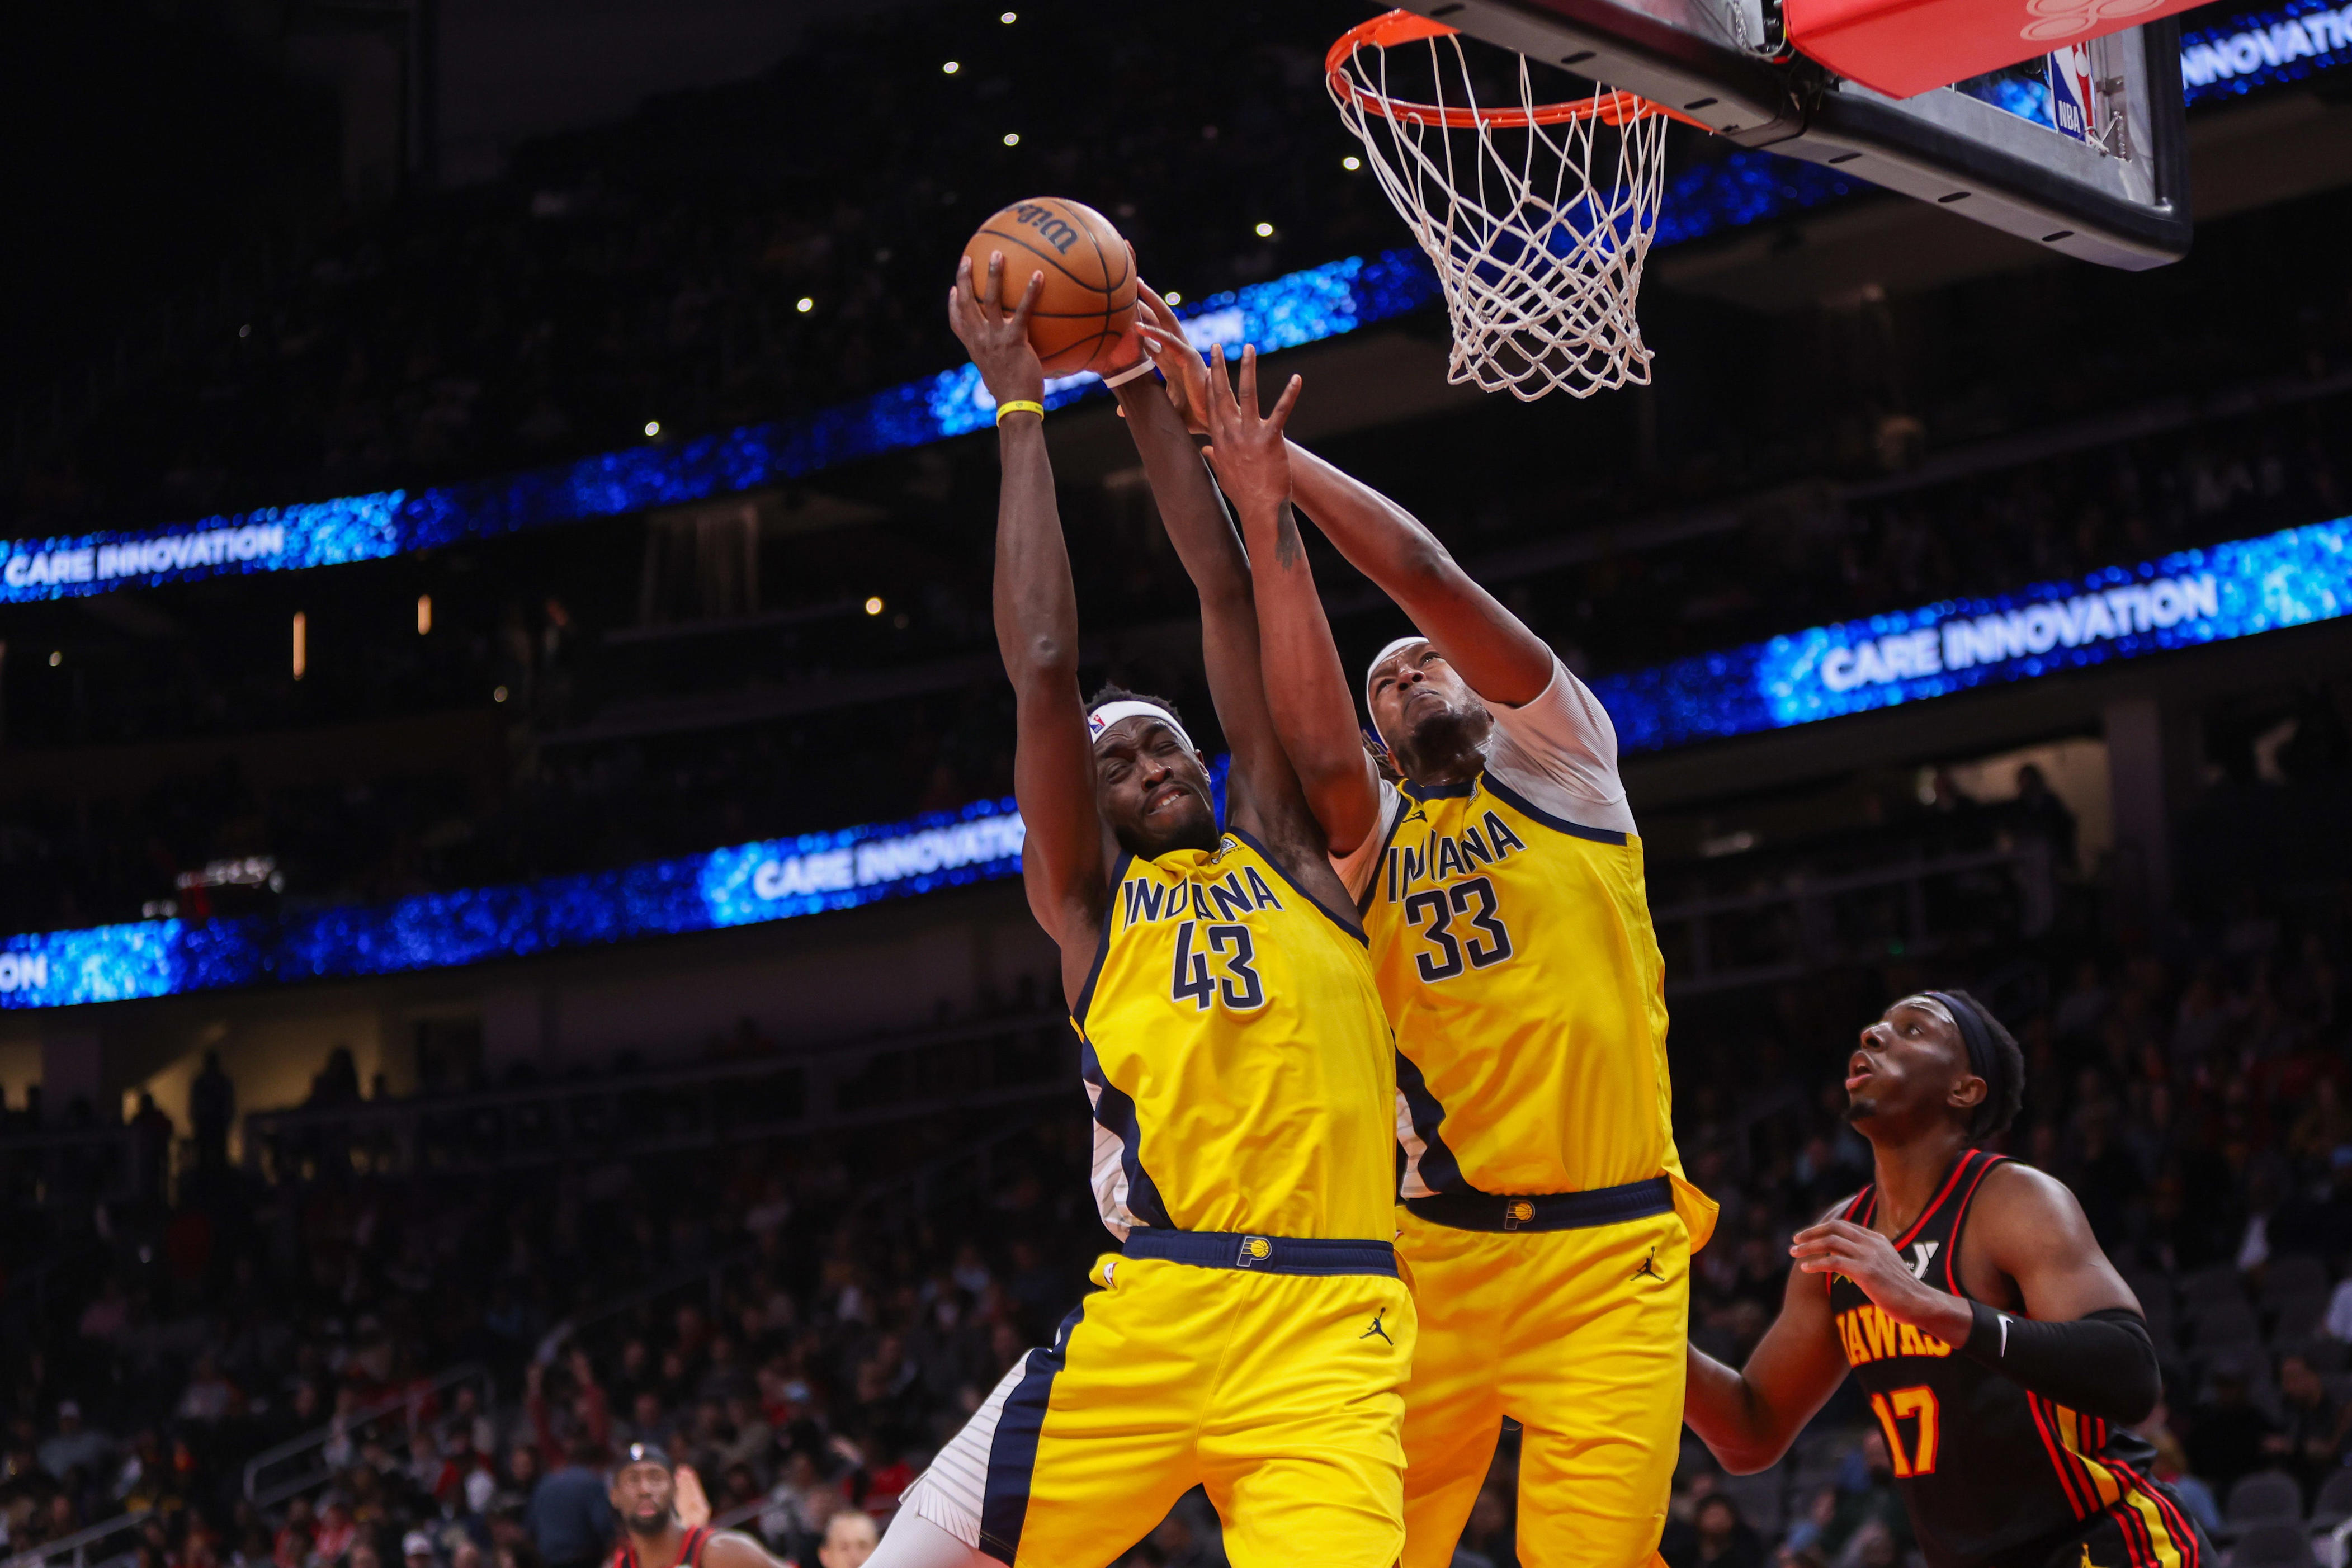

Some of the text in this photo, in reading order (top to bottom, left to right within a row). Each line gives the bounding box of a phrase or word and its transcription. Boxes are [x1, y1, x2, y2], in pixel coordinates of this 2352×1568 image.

[2058, 100, 2081, 134] NBA
[4, 521, 285, 587] CARE INNOVATION
[1820, 573, 2218, 692] CARE INNOVATION
[753, 811, 1027, 900] CARE INNOVATIO
[1172, 919, 1266, 1013] 43
[1405, 876, 1514, 984] 33
[1871, 1383, 1939, 1479] 17
